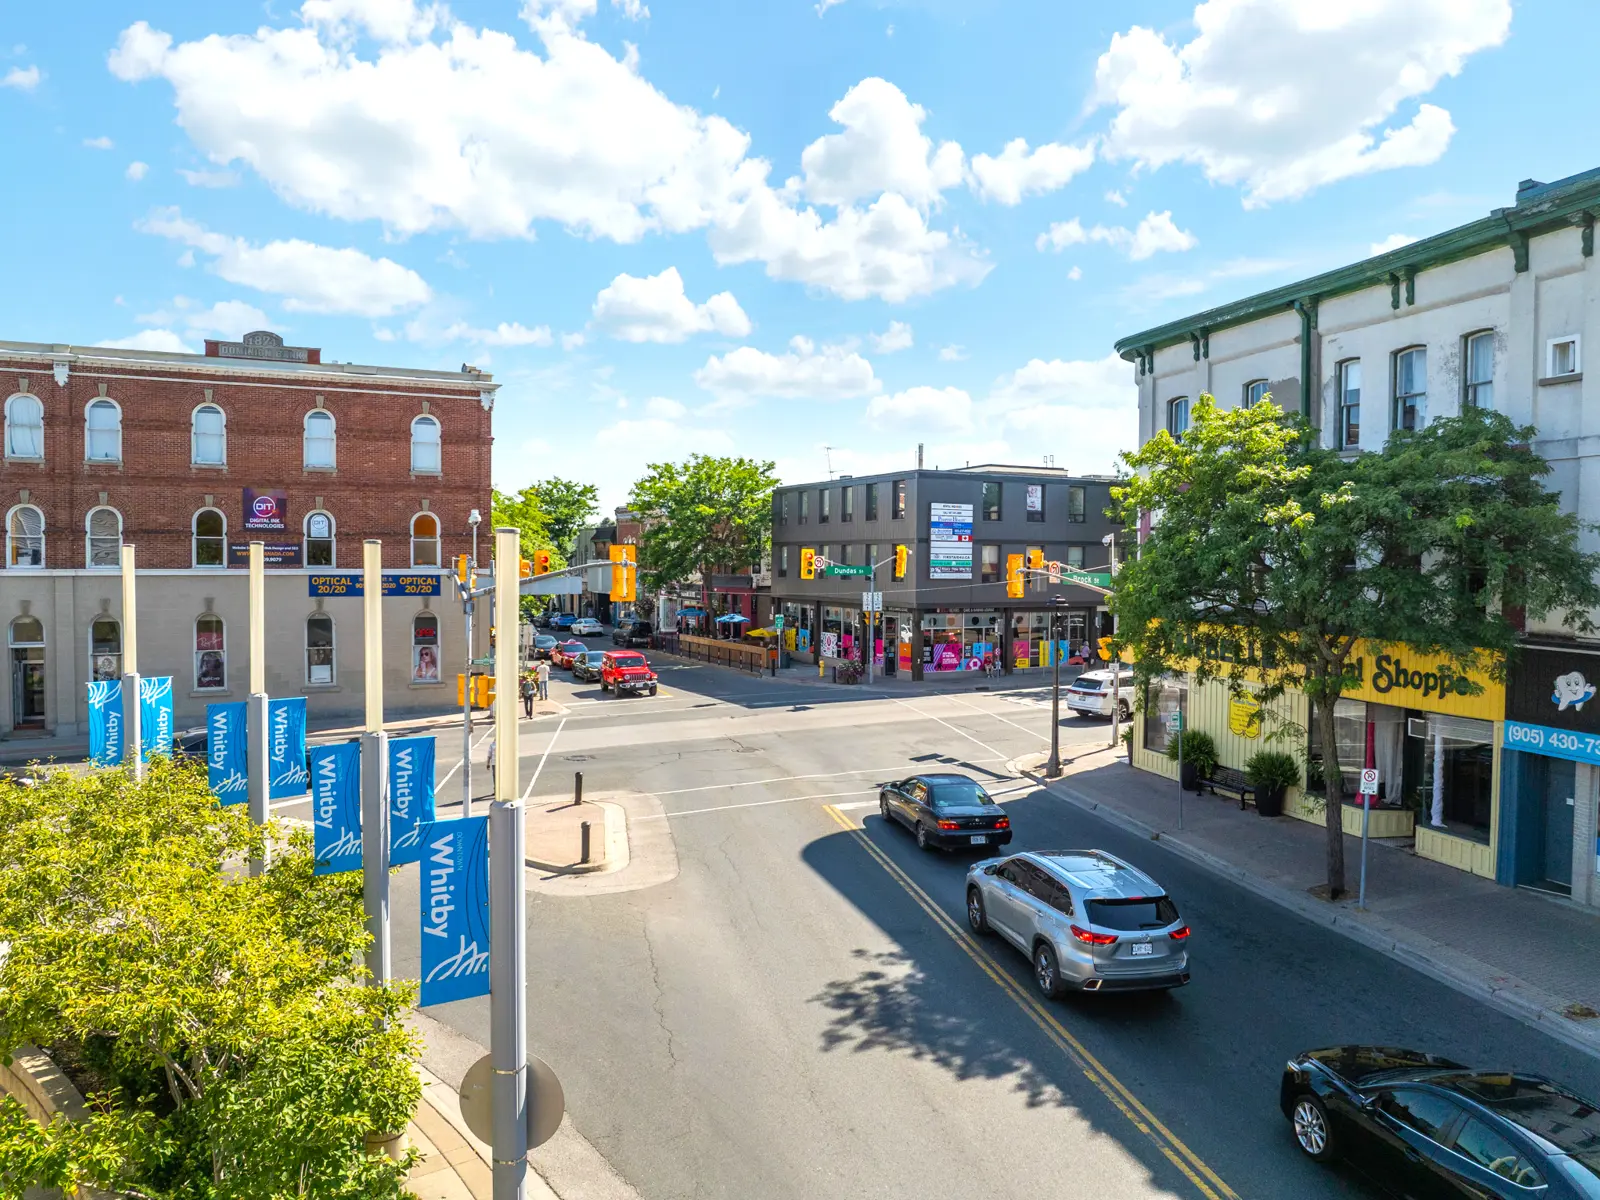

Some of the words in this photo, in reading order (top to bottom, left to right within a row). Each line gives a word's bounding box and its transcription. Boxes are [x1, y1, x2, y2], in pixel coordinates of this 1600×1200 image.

[221, 345, 272, 357] DOMINION
[255, 503, 273, 511] DIT
[311, 577, 353, 585] OPTICAL
[399, 577, 438, 586] OPTICAL
[834, 567, 857, 575] Dundas
[1072, 575, 1092, 584] Brock
[317, 585, 347, 594] 20/20
[404, 585, 433, 593] 20/20
[1371, 654, 1470, 700] Shoppe
[105, 710, 122, 761] Whitby
[156, 705, 172, 753] Whitby
[209, 711, 228, 770] Whitby
[271, 706, 288, 763] Whitby
[1508, 725, 1545, 748] (905)
[315, 754, 337, 829] Whitby
[392, 747, 413, 819] Whitby
[456, 831, 464, 871] DOWNTOWN
[423, 833, 455, 938] Whitby
